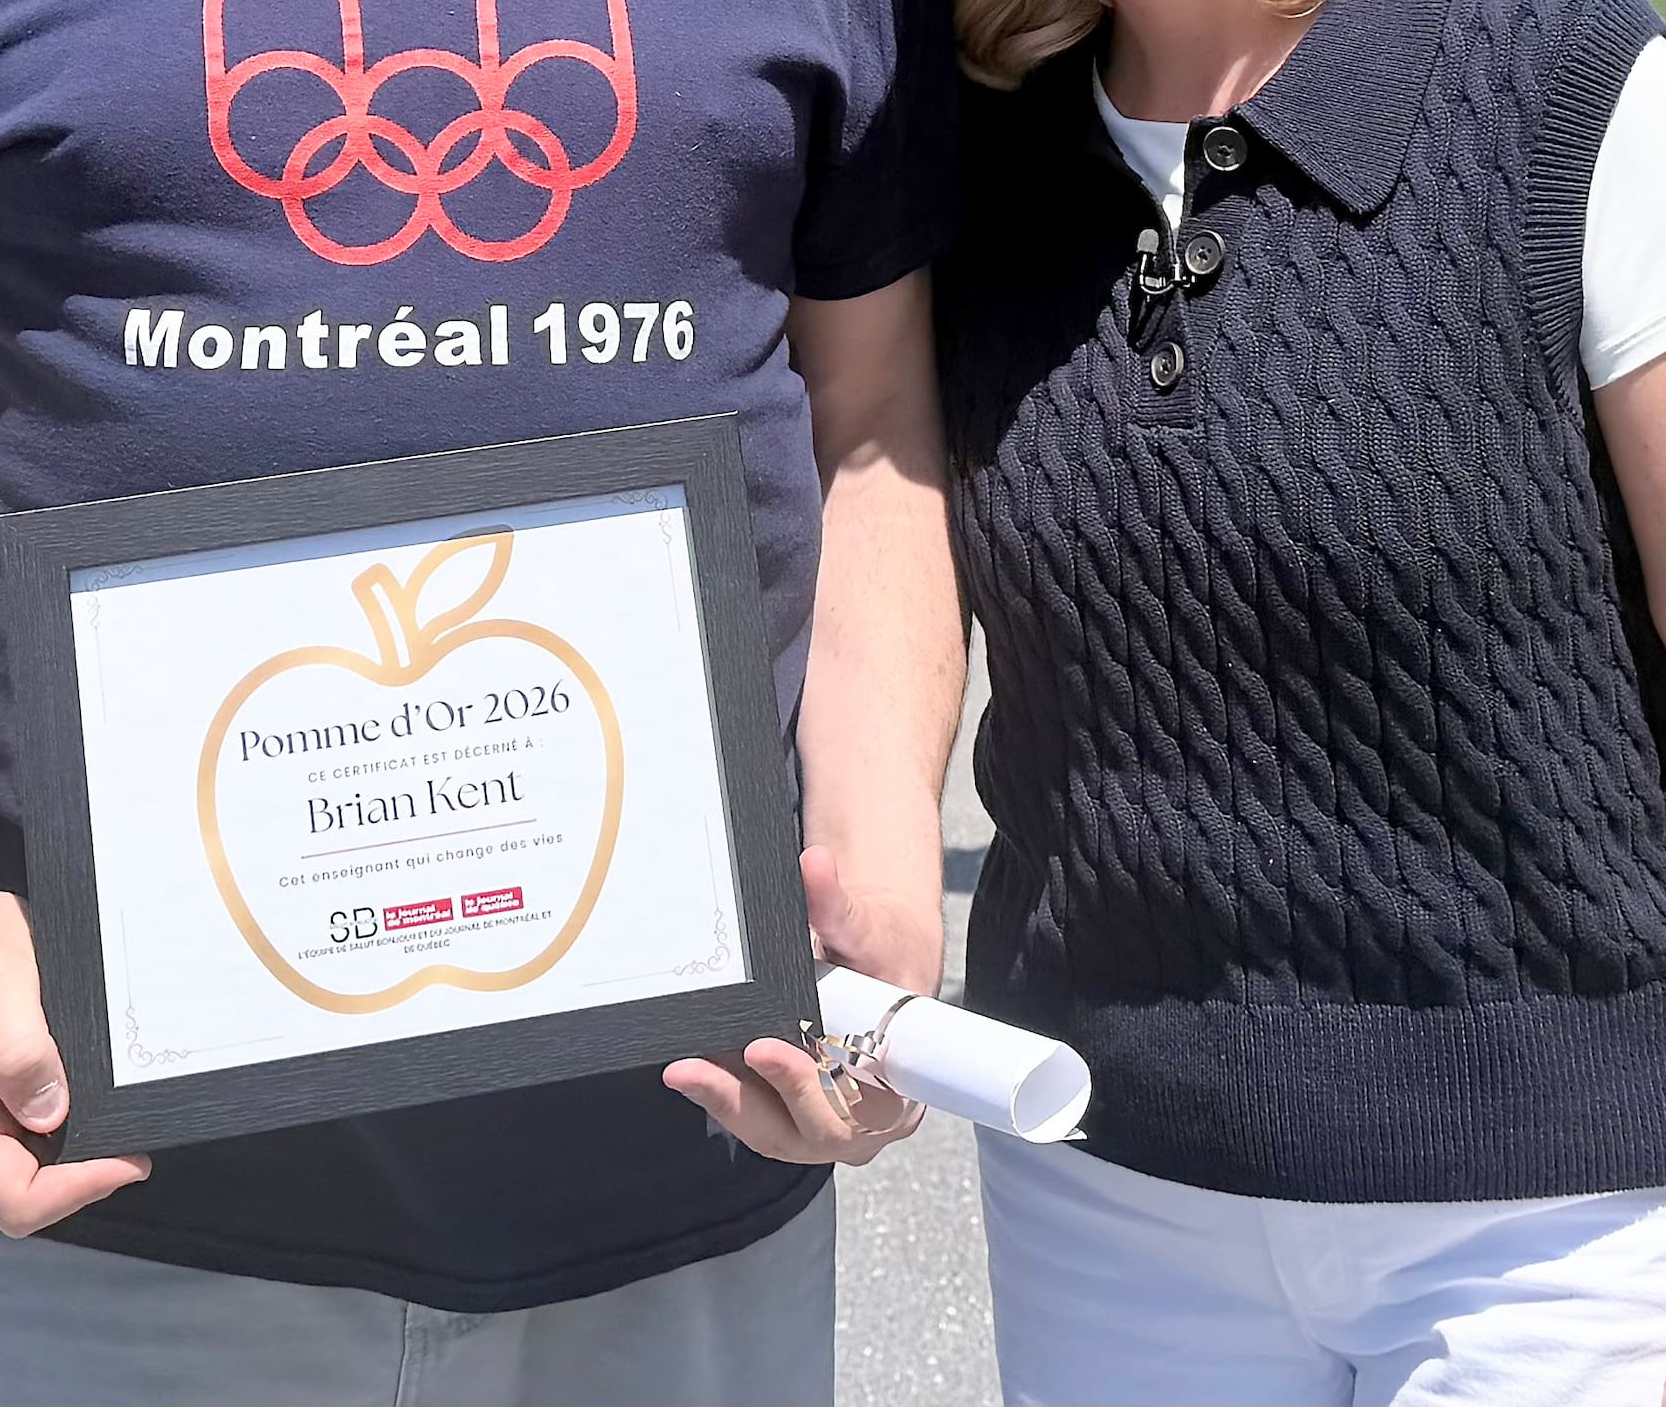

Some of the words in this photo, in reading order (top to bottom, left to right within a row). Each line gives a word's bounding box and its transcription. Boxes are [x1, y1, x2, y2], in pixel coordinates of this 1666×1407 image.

[124, 305, 509, 371] Montréal
[532, 299, 694, 364] 1976
[240, 719, 381, 761] Pomme
[484, 679, 570, 724] 2026
[308, 770, 326, 783] CE
[333, 757, 417, 779] CERTIFICAT
[424, 752, 448, 765] EST
[454, 738, 518, 760] DÉCERNÉ
[308, 793, 416, 833] Brian
[427, 771, 525, 815] Kent
[279, 874, 305, 888] Cet
[312, 859, 400, 883] enseignant
[406, 853, 430, 870] qui
[436, 845, 493, 863] change
[500, 837, 526, 852] des
[533, 833, 563, 845] vies
[330, 907, 378, 943] SB
